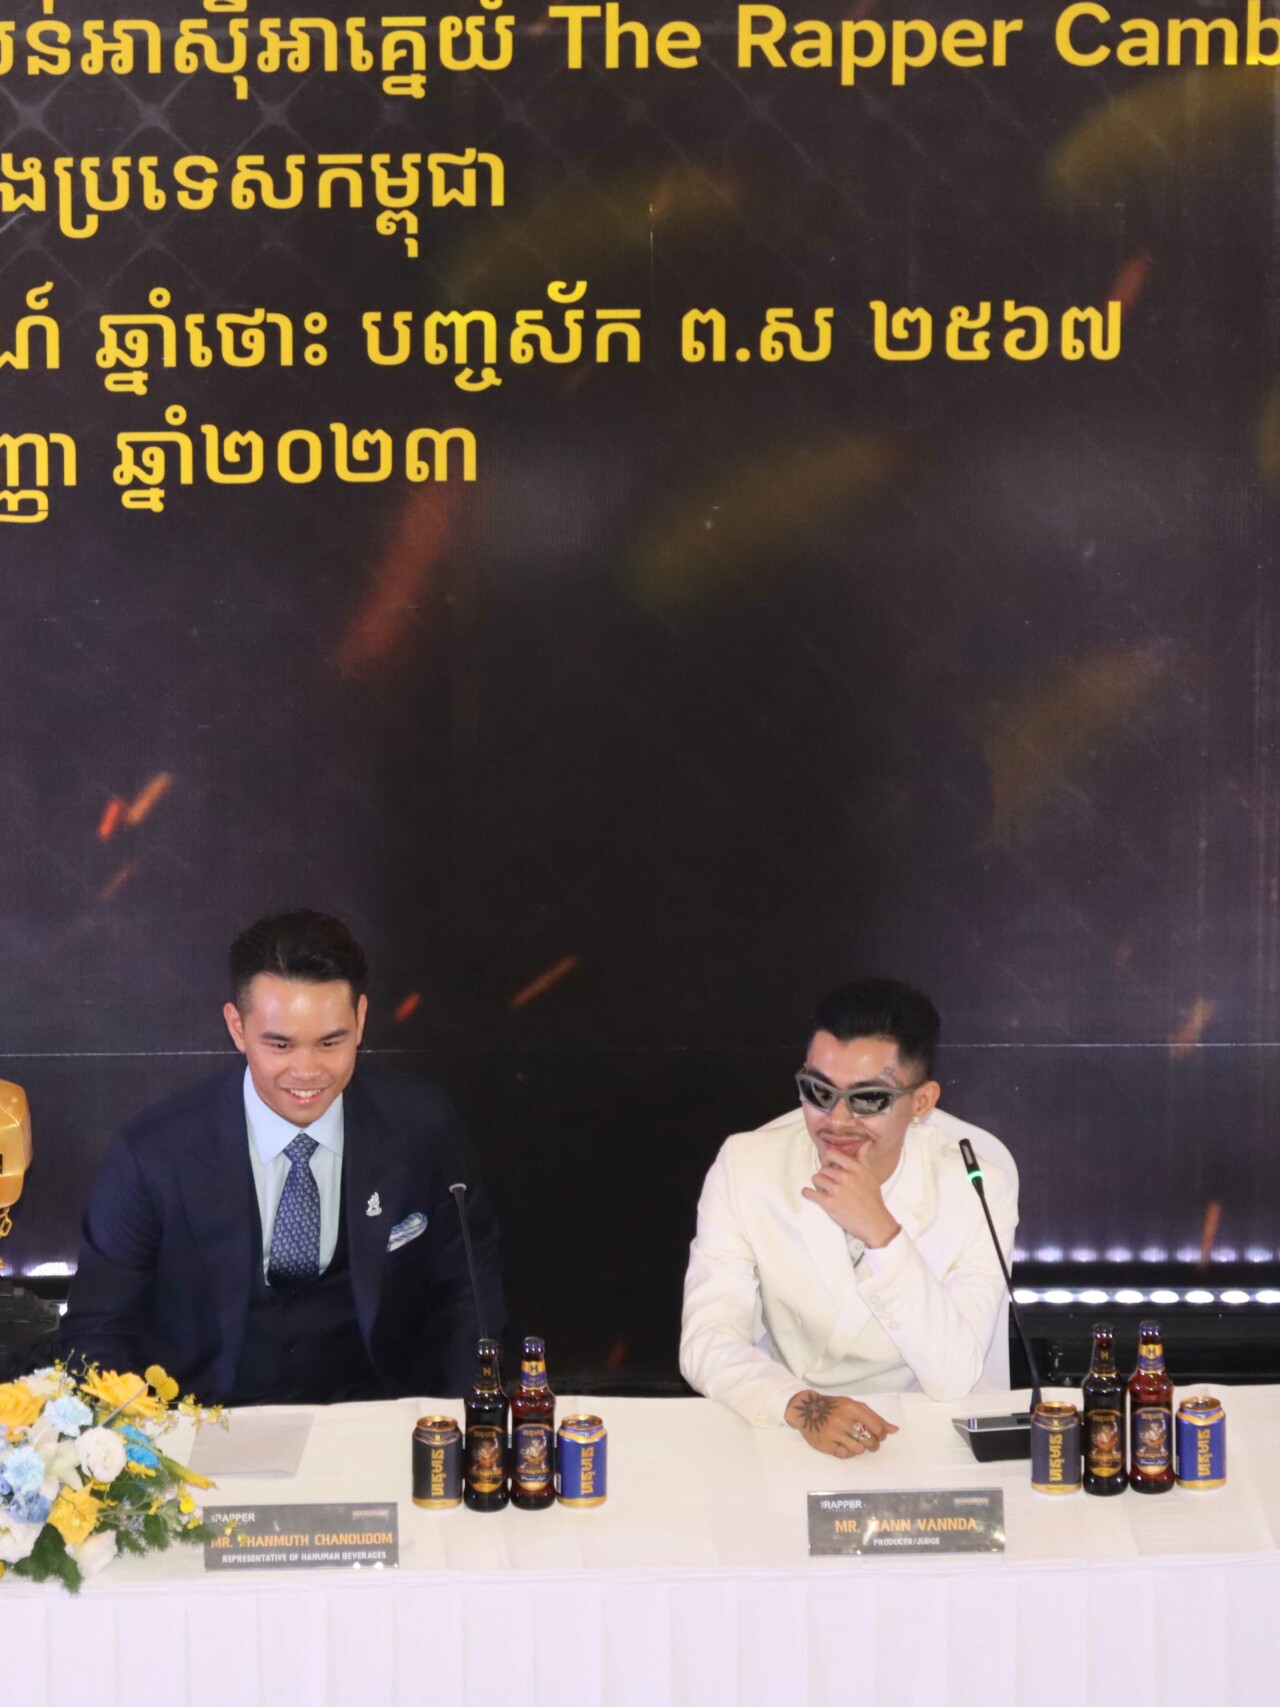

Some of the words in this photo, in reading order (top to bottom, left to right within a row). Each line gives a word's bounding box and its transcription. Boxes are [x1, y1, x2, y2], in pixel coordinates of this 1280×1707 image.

[549, 3, 702, 69] The
[738, 4, 1024, 86] Rapper
[1055, 0, 1280, 67] Camb
[95, 287, 328, 396] ឆ្នាំថោះ
[362, 280, 641, 392] បញ្ចស័ក
[681, 308, 834, 363] ព.ស
[869, 301, 1122, 361] ២៥៦៧
[112, 404, 477, 513] ឆ្នាំ២០២៣
[824, 1500, 862, 1509] RAPPER
[835, 1519, 860, 1533] MR.
[917, 1516, 977, 1532] VANNDA
[211, 1535, 233, 1549] MR.
[239, 1534, 310, 1548] HANMUTH
[314, 1532, 393, 1547] CHANOUDOM
[222, 1554, 287, 1563] REPRESENTATIVE
[289, 1554, 300, 1562] OF
[301, 1553, 341, 1561] HANUMAN
[342, 1551, 387, 1560] BEVERAGES
